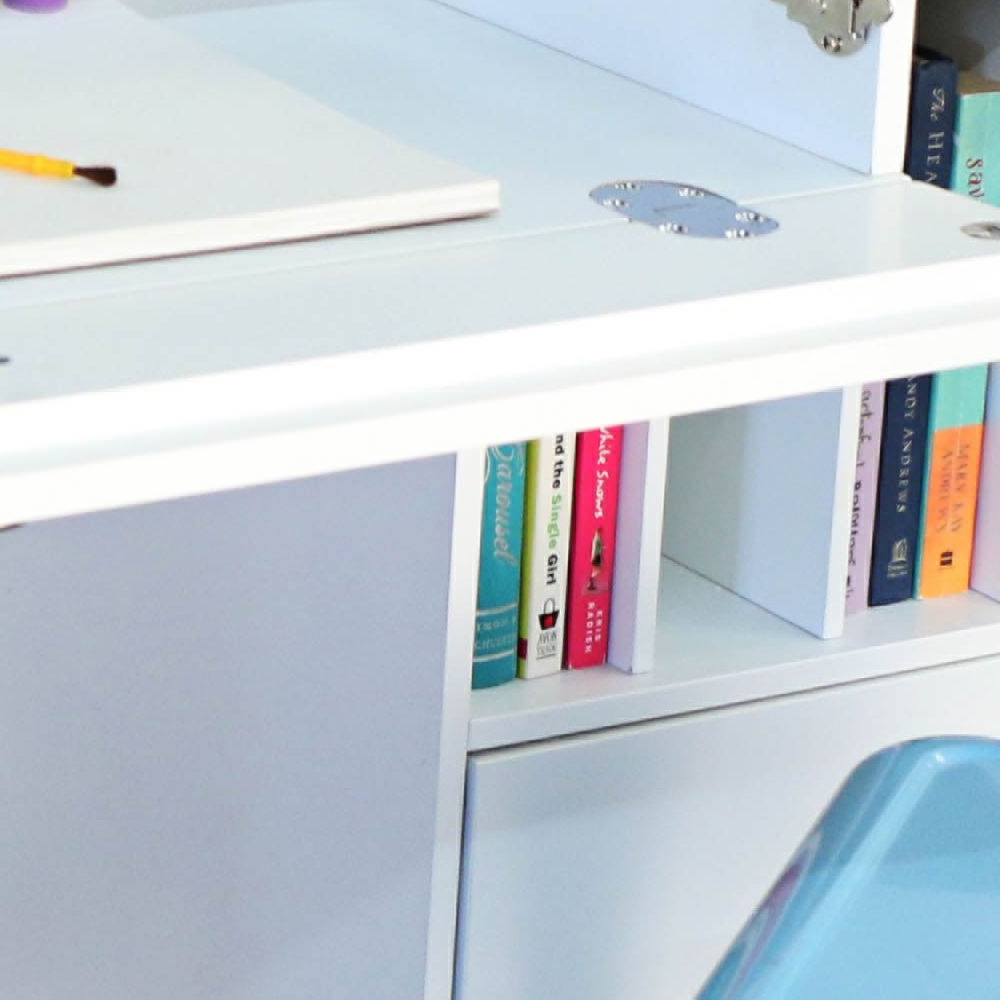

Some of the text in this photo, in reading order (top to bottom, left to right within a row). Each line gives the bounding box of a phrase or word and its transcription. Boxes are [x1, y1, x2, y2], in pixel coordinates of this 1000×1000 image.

[929, 87, 946, 121] The
[552, 460, 564, 489] the
[896, 428, 914, 513] ANDREWS
[594, 470, 609, 518] Snows
[547, 494, 562, 549] Single
[546, 554, 558, 585] Girl
